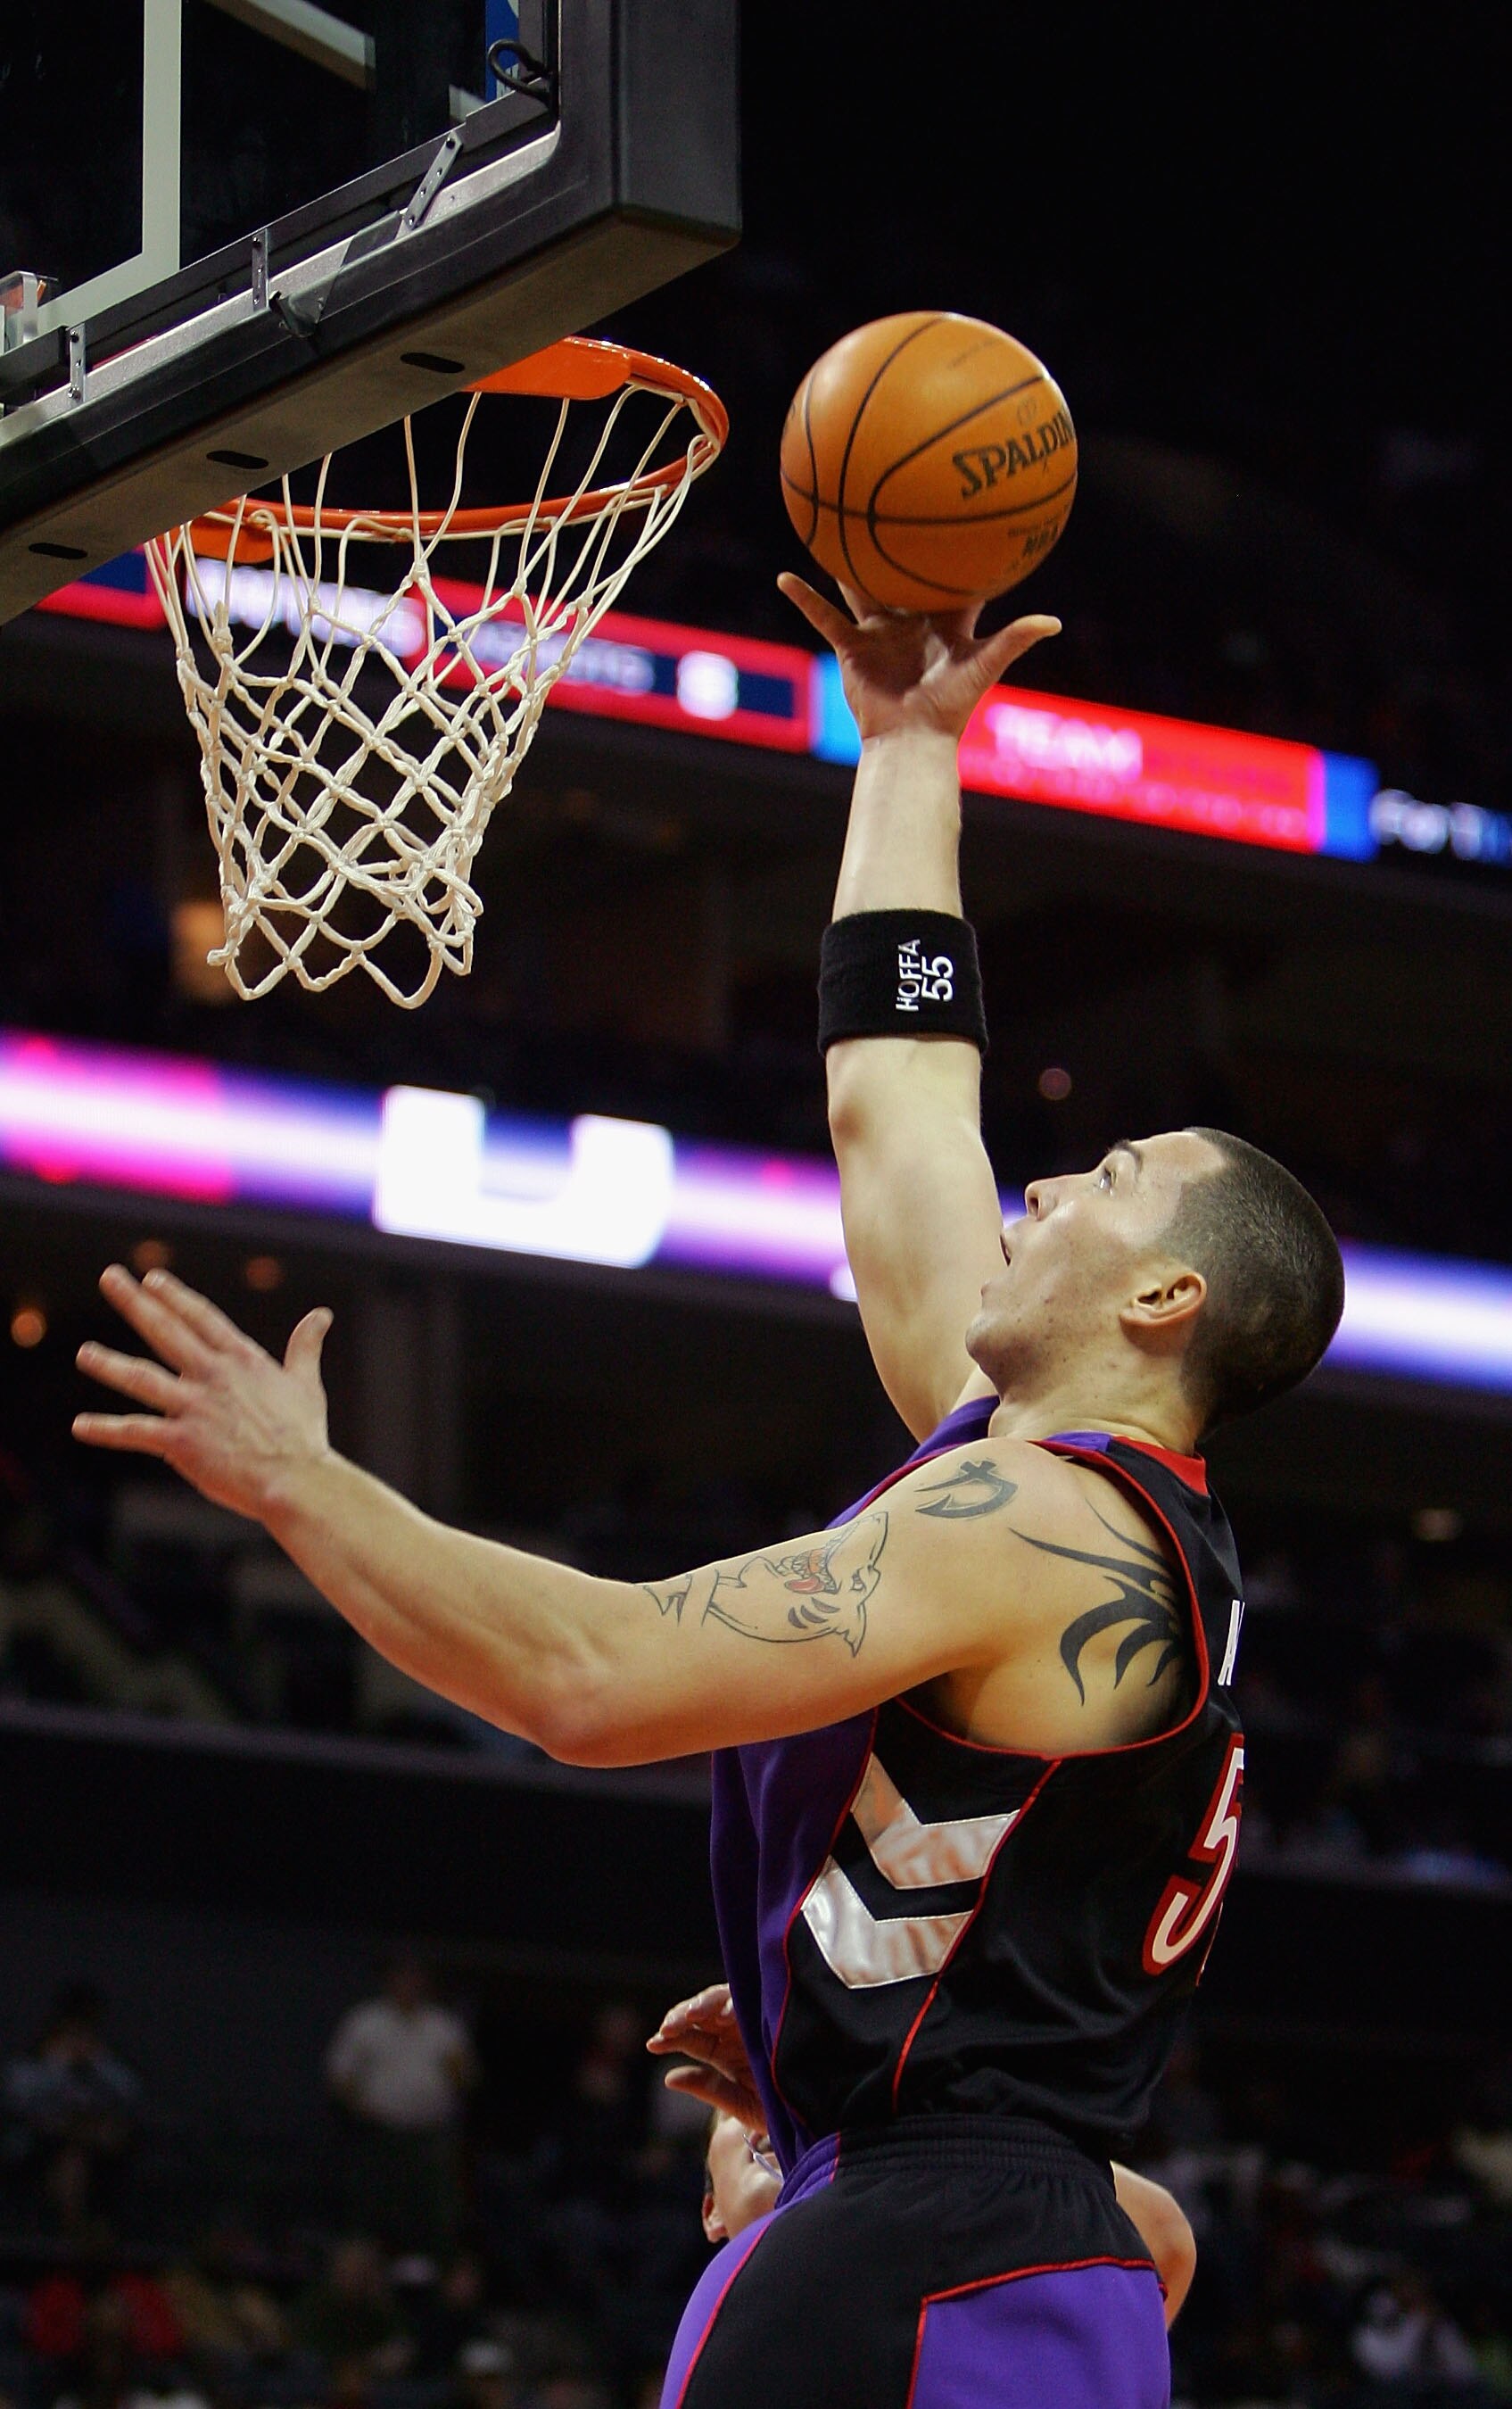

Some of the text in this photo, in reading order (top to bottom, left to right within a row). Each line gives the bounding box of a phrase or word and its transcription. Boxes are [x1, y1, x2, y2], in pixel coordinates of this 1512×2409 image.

[896, 939, 921, 1012] HOFFA
[921, 956, 954, 1002] 55
[1142, 1732, 1245, 1987] 5
